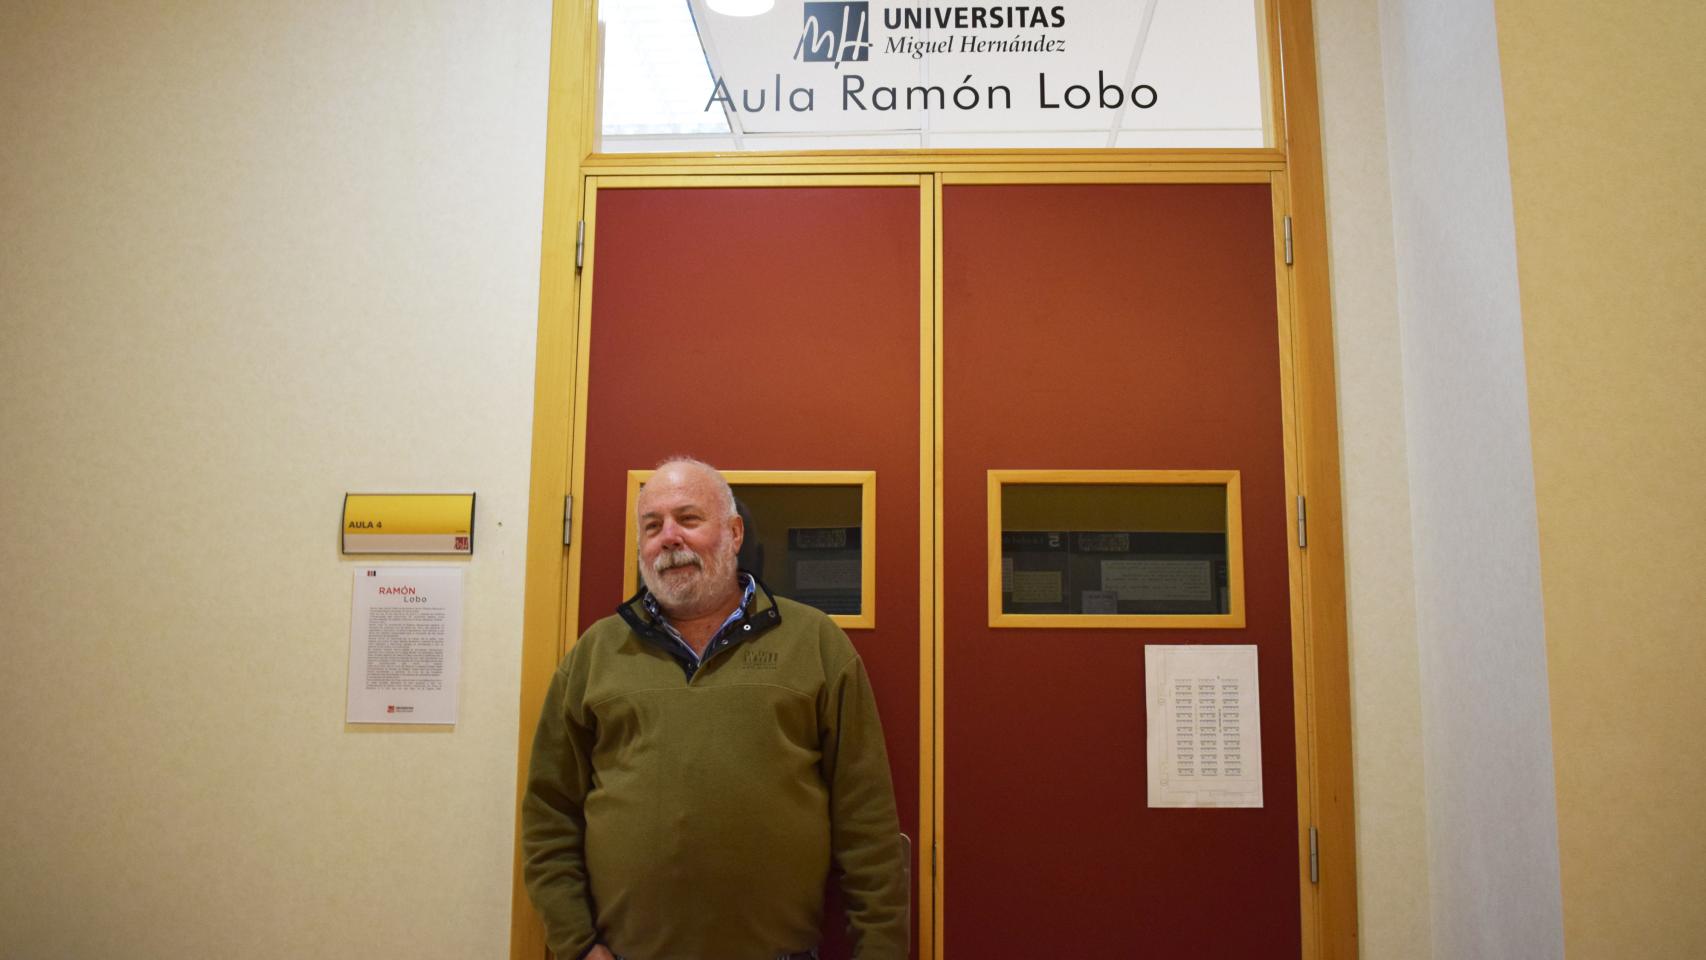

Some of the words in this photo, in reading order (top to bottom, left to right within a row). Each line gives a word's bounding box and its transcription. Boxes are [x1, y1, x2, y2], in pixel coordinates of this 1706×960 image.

[884, 5, 1066, 30] UNIVERSITAS
[884, 35, 953, 60] Miguel
[960, 34, 1066, 54] Hernández
[704, 74, 815, 113] Aula
[842, 74, 1012, 113] Ramón
[1040, 70, 1159, 110] Lobo
[376, 520, 382, 528] 4
[378, 585, 416, 595] RAMÓN
